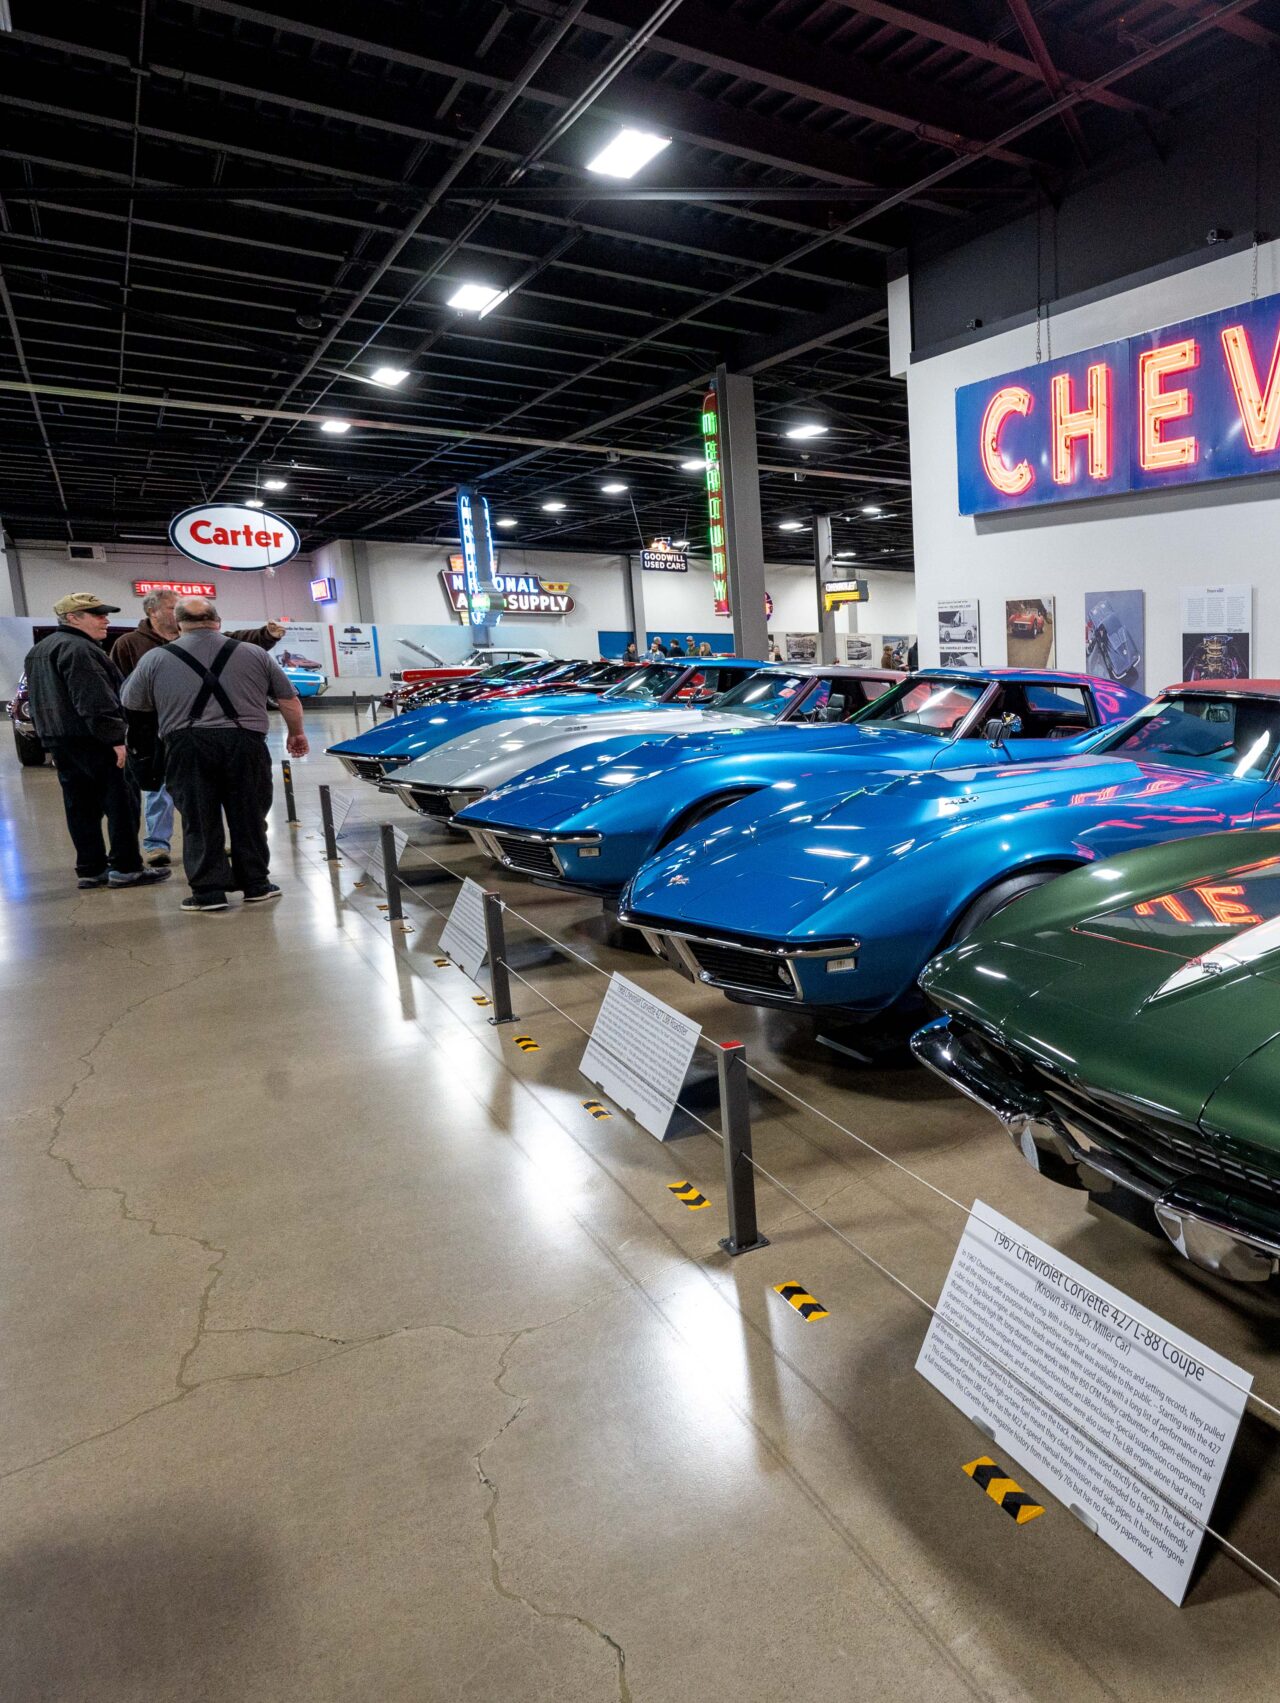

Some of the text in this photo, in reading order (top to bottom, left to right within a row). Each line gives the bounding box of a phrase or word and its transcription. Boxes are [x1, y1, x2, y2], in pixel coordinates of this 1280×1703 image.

[189, 520, 284, 548] Carter
[644, 552, 685, 562] GOODWILL
[644, 560, 686, 570] USED CARS
[452, 575, 539, 594] NONAL
[508, 594, 569, 611] SUPPLY
[994, 1229, 1205, 1381] 1967 Chevrolet Corvette 427 L-88 Coupe
[1034, 1280, 1131, 1356] (Known as the Dr. Miller Car)
[1096, 1376, 1111, 1392] along
[1112, 1388, 1124, 1400] with
[1129, 1399, 1142, 1415] long
[1142, 1409, 1152, 1420] list
[1158, 1423, 1197, 1454] performance
[1198, 1452, 1215, 1466] mod-
[1101, 1394, 1211, 1482] Holley carburetor; An open-element air
[1118, 1375, 1220, 1454] to the public. Starting with the 427
[1119, 1362, 1225, 1440] races and setting records, they pulled
[1086, 1415, 1096, 1426] also
[1097, 1424, 1110, 1438] used.
[1111, 1434, 1122, 1447] The
[1122, 1442, 1133, 1455] L88
[1133, 1453, 1153, 1472] engine
[1153, 1469, 1170, 1485] alone
[1171, 1480, 1184, 1495] had
[1188, 1496, 1202, 1510] cost
[1090, 1403, 1205, 1498] exclusive. Special suspension components,
[1063, 1475, 1152, 1558] 70s but has no factory paperwork.
[1074, 1453, 1187, 1553] were never intended to be street-friendly.
[1085, 1446, 1193, 1538] were used strictly for racing. The lack of
[1092, 1485, 1183, 1566] and side-pipes. It has undergone
